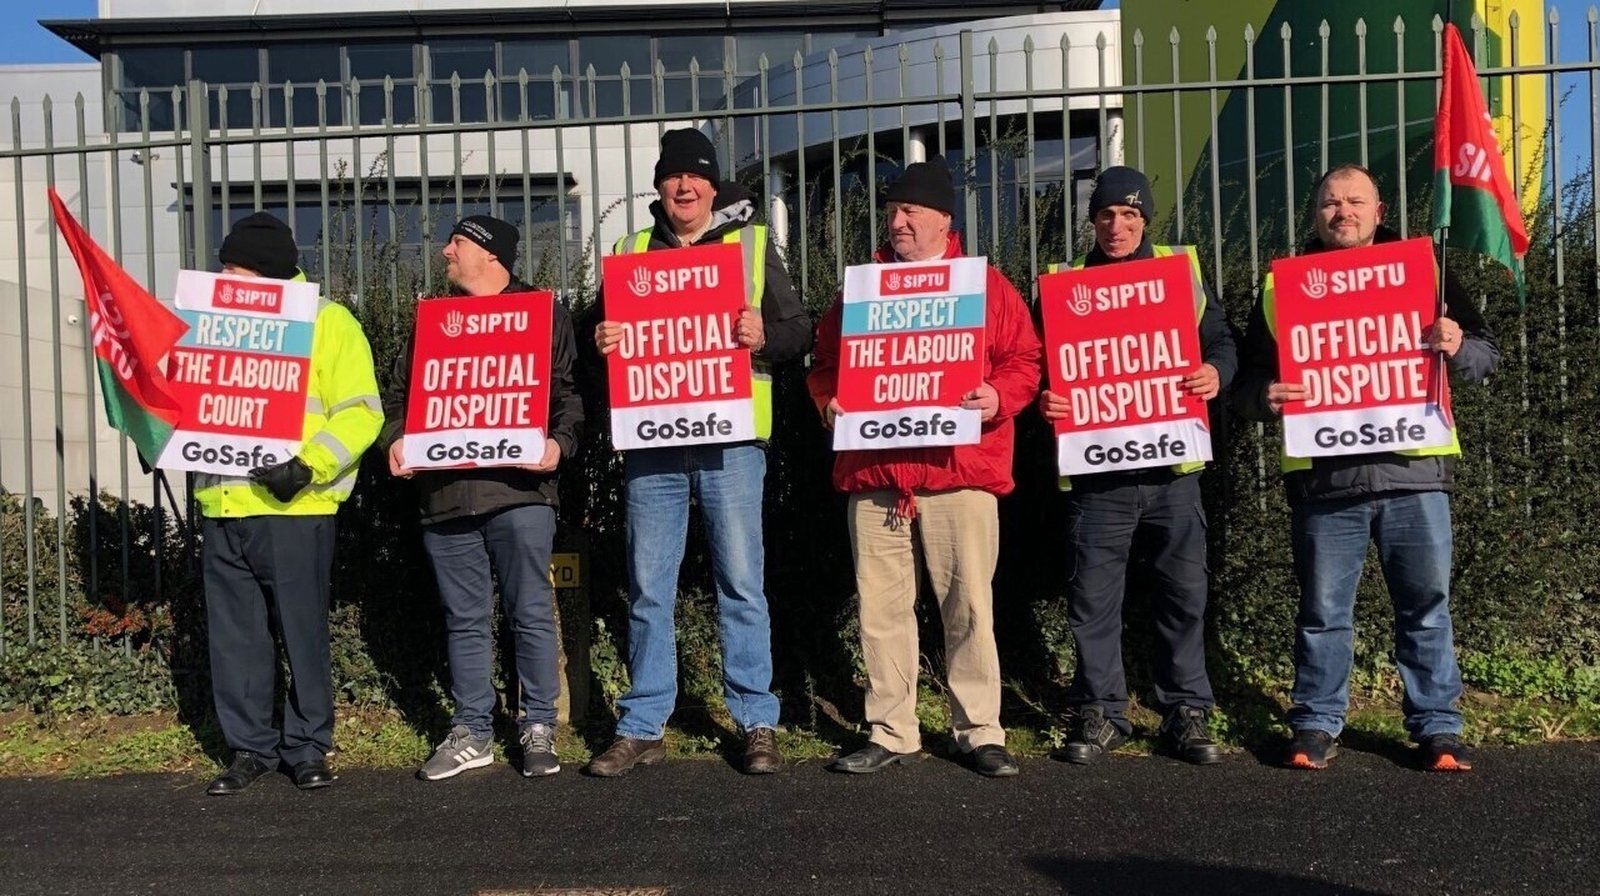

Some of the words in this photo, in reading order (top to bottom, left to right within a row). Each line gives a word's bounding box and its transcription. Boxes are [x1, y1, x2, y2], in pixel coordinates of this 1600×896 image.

[654, 265, 719, 293] SIPTU
[903, 273, 944, 288] SIPTU
[1331, 262, 1406, 294] SIPTU
[235, 288, 277, 306] SIPTU
[1095, 279, 1165, 311] SIPTU
[466, 311, 529, 334] SIPTU
[867, 297, 959, 331] RESPECT
[196, 314, 289, 351] RESPECT
[618, 312, 739, 360] OFFICIAL
[1290, 311, 1431, 363] OFFICIAL
[847, 338, 887, 369] THE
[890, 332, 975, 366] LABOUR
[1059, 329, 1189, 382] OFFICIAL
[174, 351, 214, 385] THE
[217, 355, 301, 392] LABOUR
[423, 353, 540, 391] OFFICIAL
[627, 356, 735, 402] DISPUTE
[873, 371, 944, 404] COURT
[1302, 357, 1427, 408] DISPUTE
[198, 393, 269, 429] COURT
[424, 392, 532, 430] DISPUTE
[1071, 375, 1188, 426] DISPUTE
[637, 412, 733, 441] GoSafe
[859, 413, 957, 440] GoSafe
[1314, 417, 1426, 449] GoSafe
[182, 441, 278, 468] GoSafe
[426, 438, 523, 462] GoSafe
[1084, 434, 1187, 466] GoSafe
